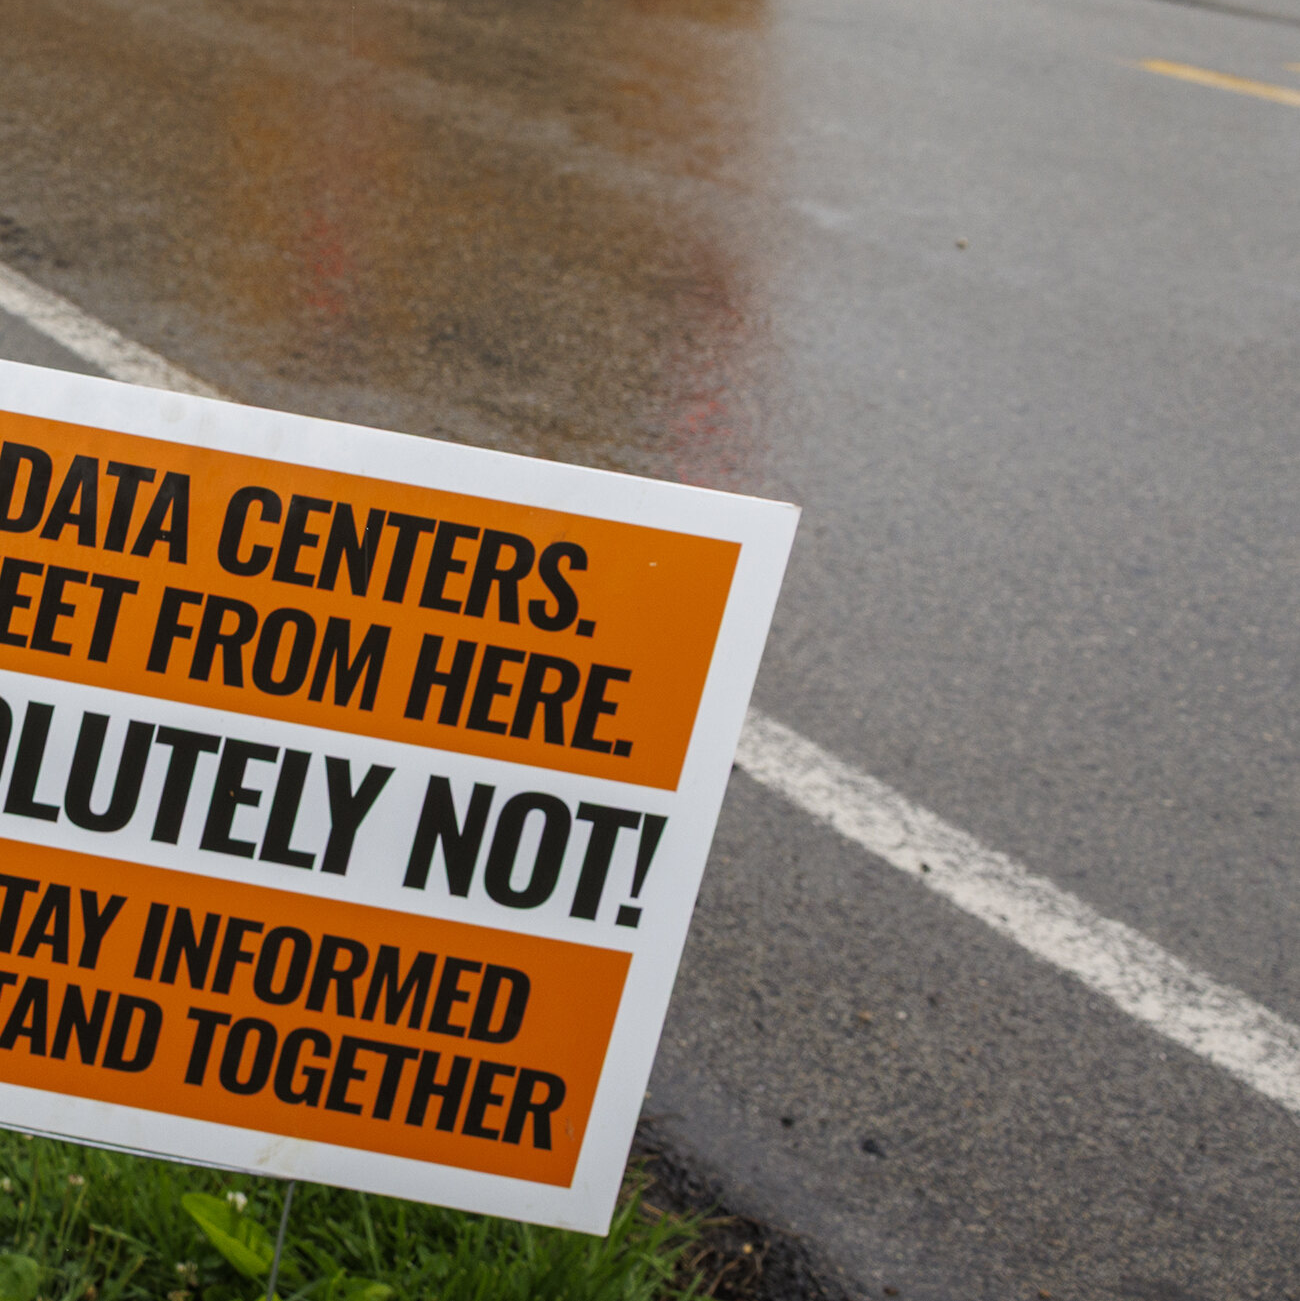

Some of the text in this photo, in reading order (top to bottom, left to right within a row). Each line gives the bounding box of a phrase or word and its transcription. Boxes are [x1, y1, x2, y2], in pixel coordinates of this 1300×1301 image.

[216, 485, 597, 638] CENTERS.
[146, 585, 392, 713] FROM
[404, 632, 634, 759] HERE.
[403, 774, 669, 929] NOT!
[133, 901, 532, 1045] INFORMED
[184, 1006, 567, 1153] TOGETHER
